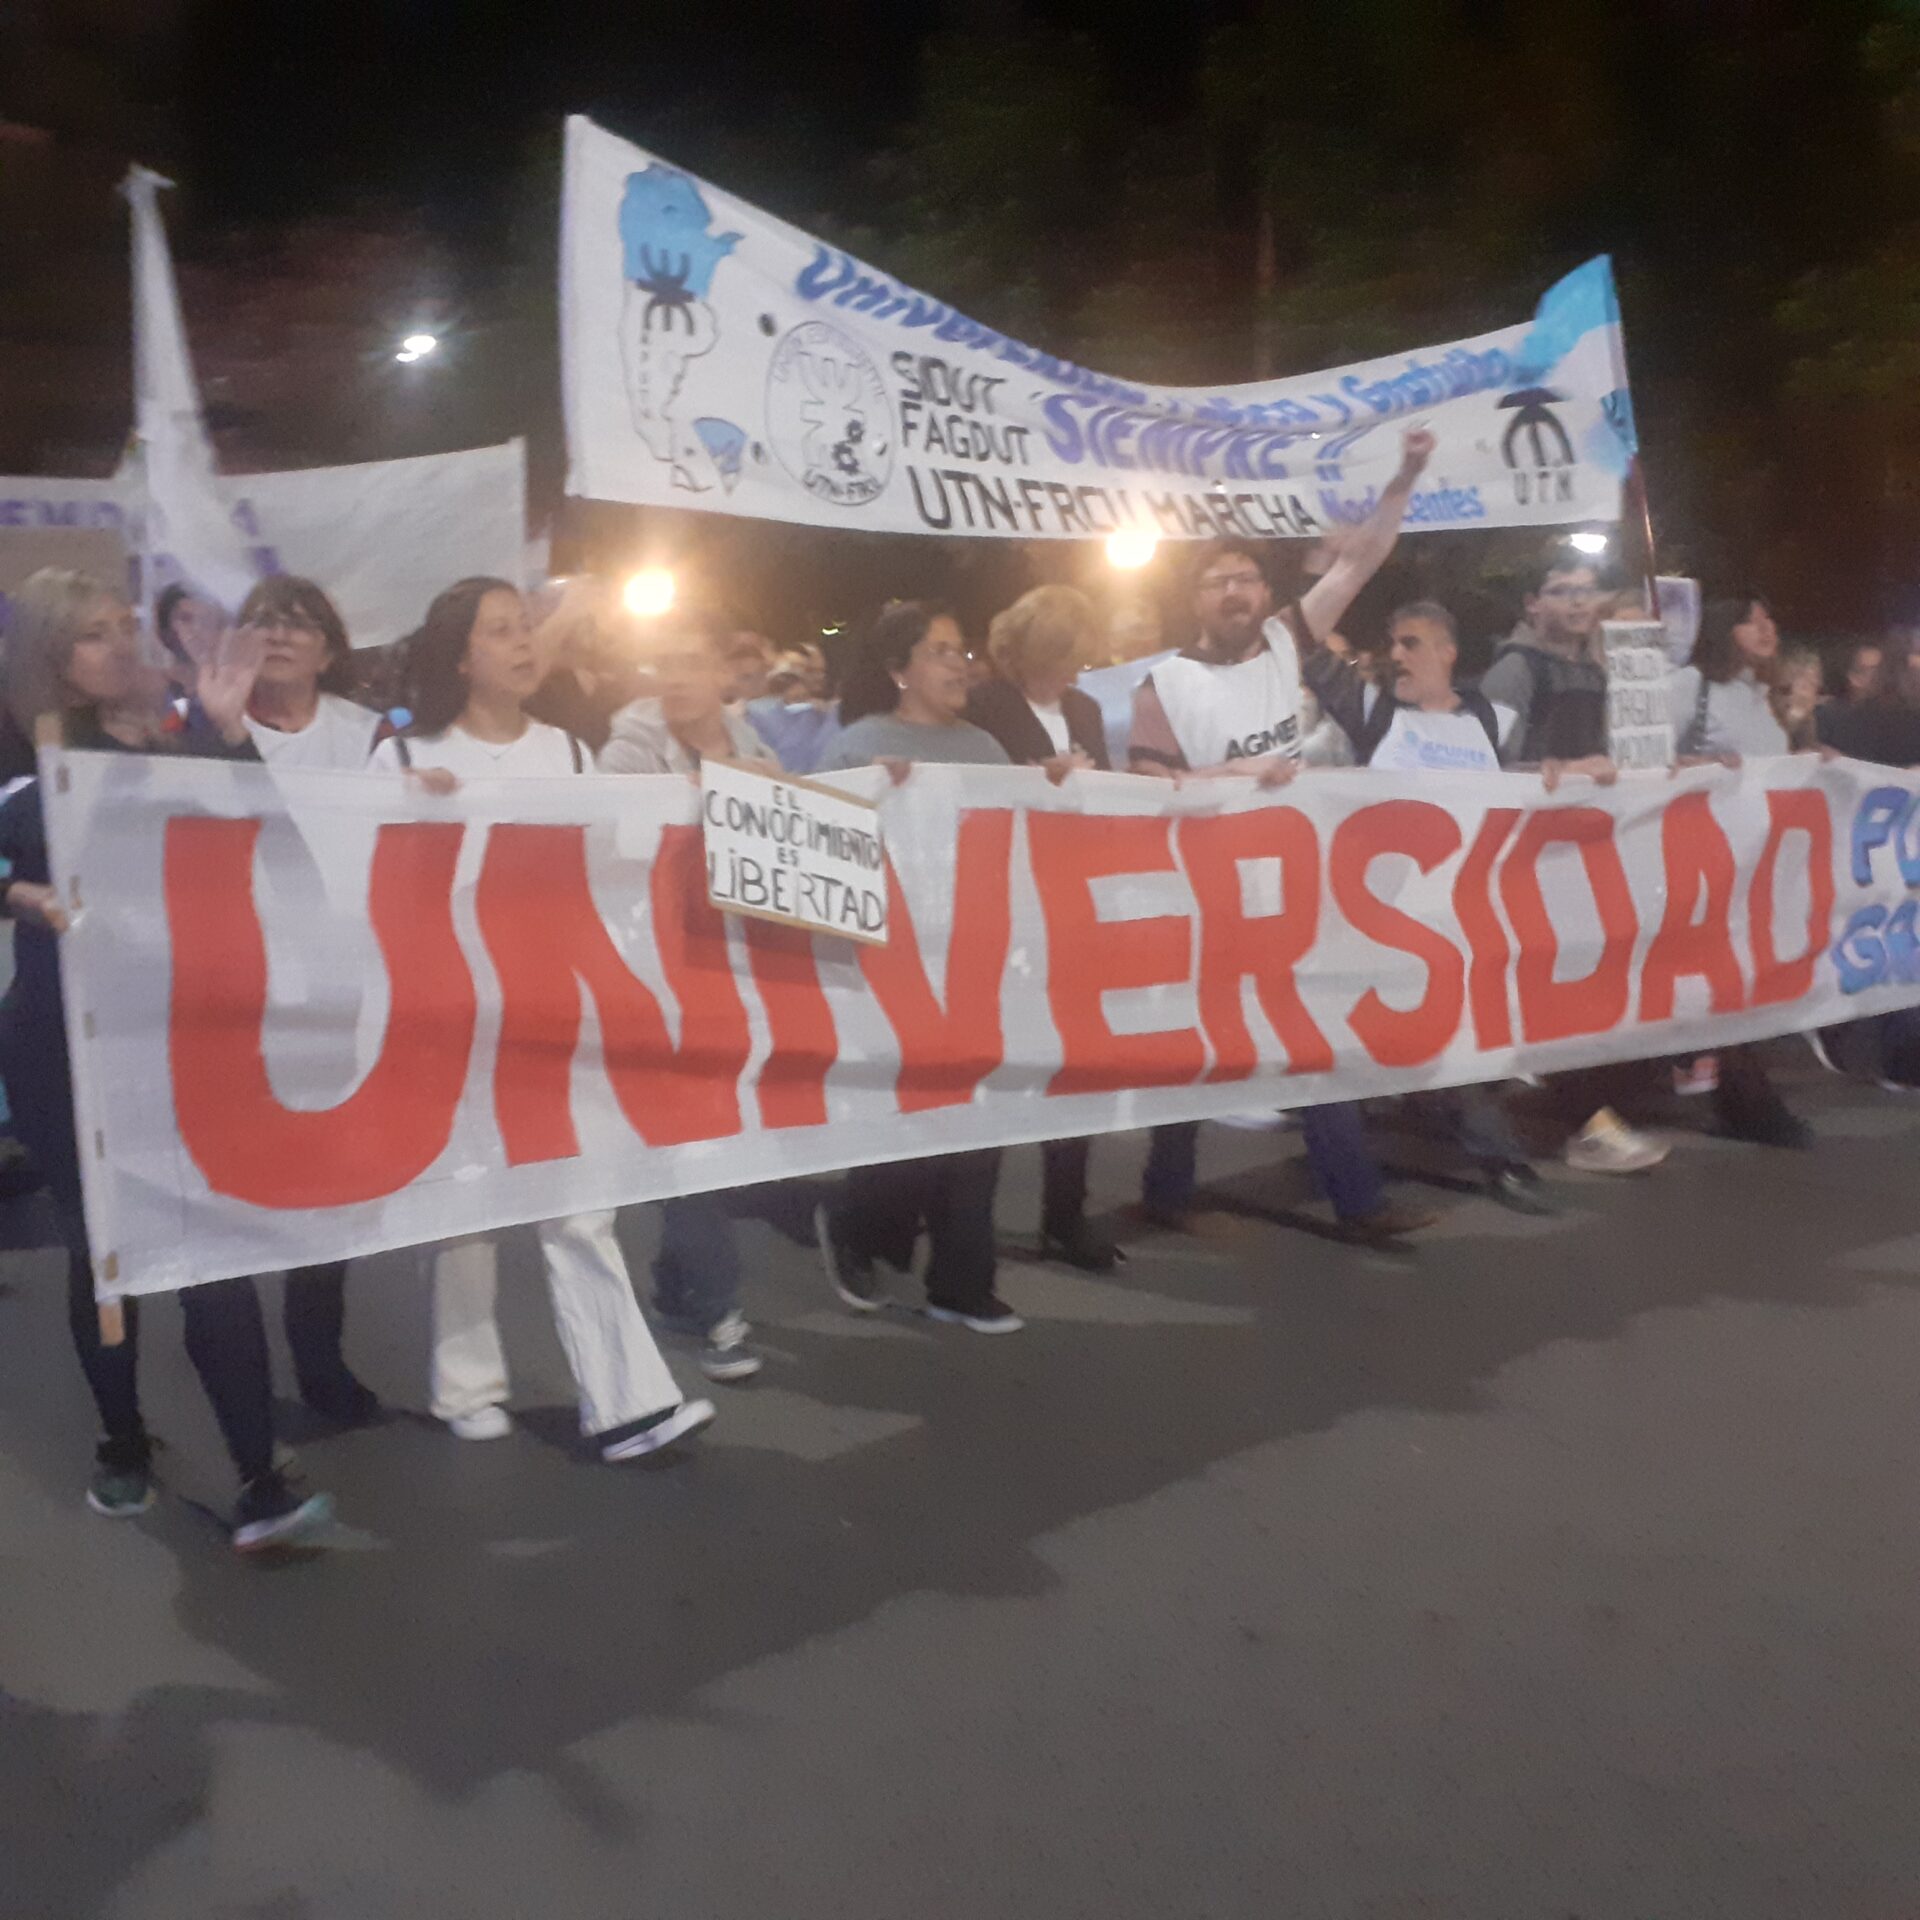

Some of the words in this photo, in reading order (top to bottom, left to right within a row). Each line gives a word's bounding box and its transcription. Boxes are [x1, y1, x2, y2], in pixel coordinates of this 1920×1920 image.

[902, 401, 1030, 465] FAGDUT
[1144, 486, 1321, 538] MARCHA
[772, 785, 804, 810] EL
[164, 788, 1836, 1209] UNIVERSIDAD
